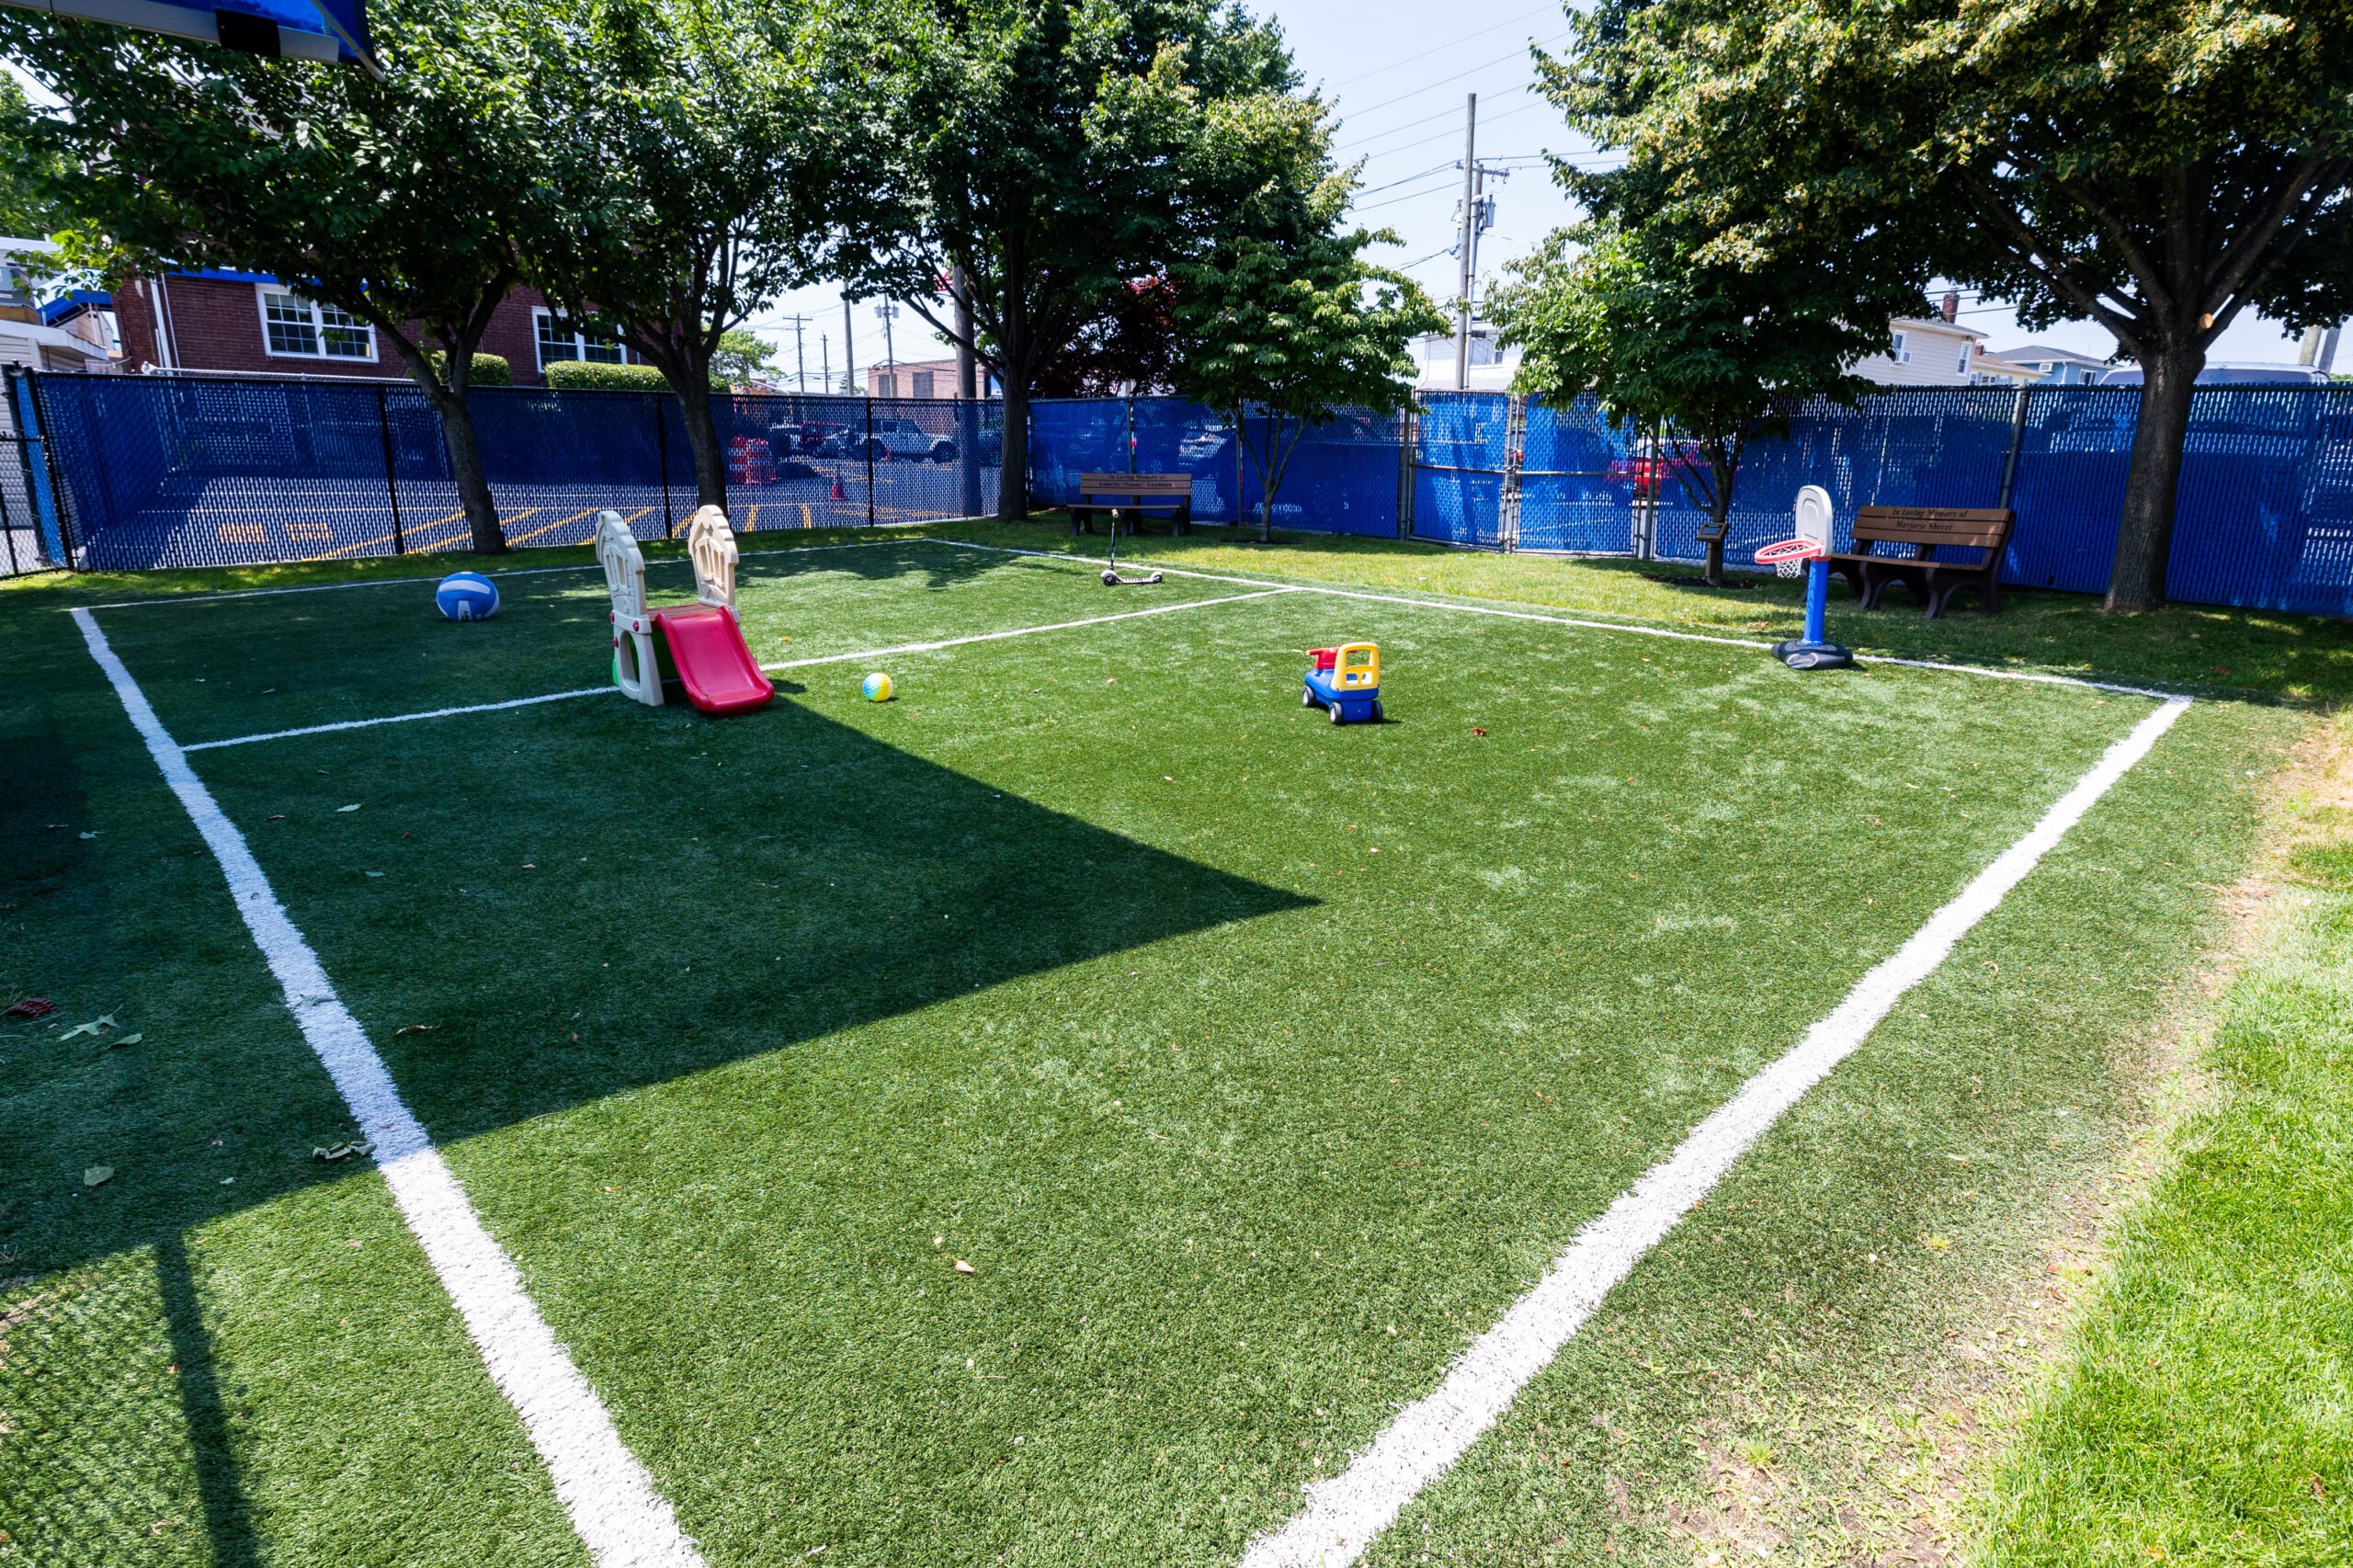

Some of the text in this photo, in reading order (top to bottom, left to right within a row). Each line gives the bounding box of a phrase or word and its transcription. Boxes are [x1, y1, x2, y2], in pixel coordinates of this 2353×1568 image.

[1902, 508, 1925, 517] Loving
[1927, 509, 1957, 518] Memory
[1959, 510, 1969, 518] of
[1896, 520, 1927, 530] Marjorie
